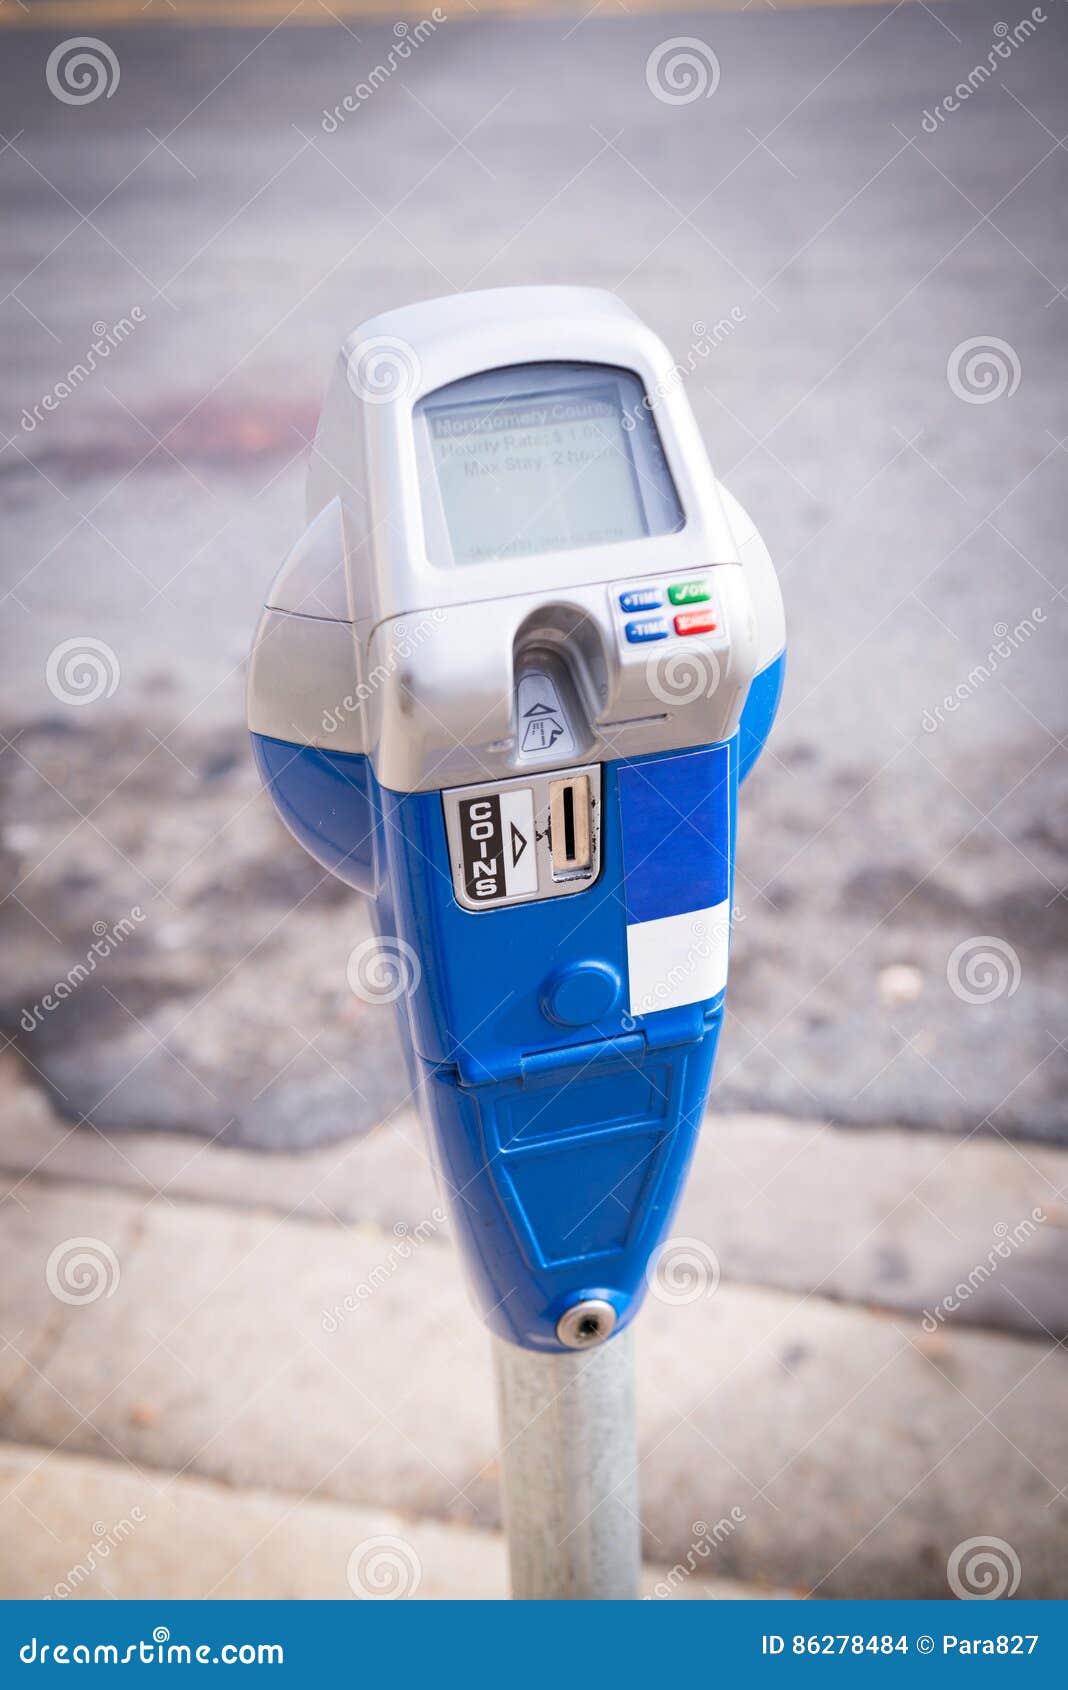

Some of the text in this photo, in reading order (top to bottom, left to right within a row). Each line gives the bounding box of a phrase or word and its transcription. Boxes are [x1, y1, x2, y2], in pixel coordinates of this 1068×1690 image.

[436, 409, 547, 433] Montgomery
[464, 460, 499, 478] Max
[469, 802, 499, 897] COINS
